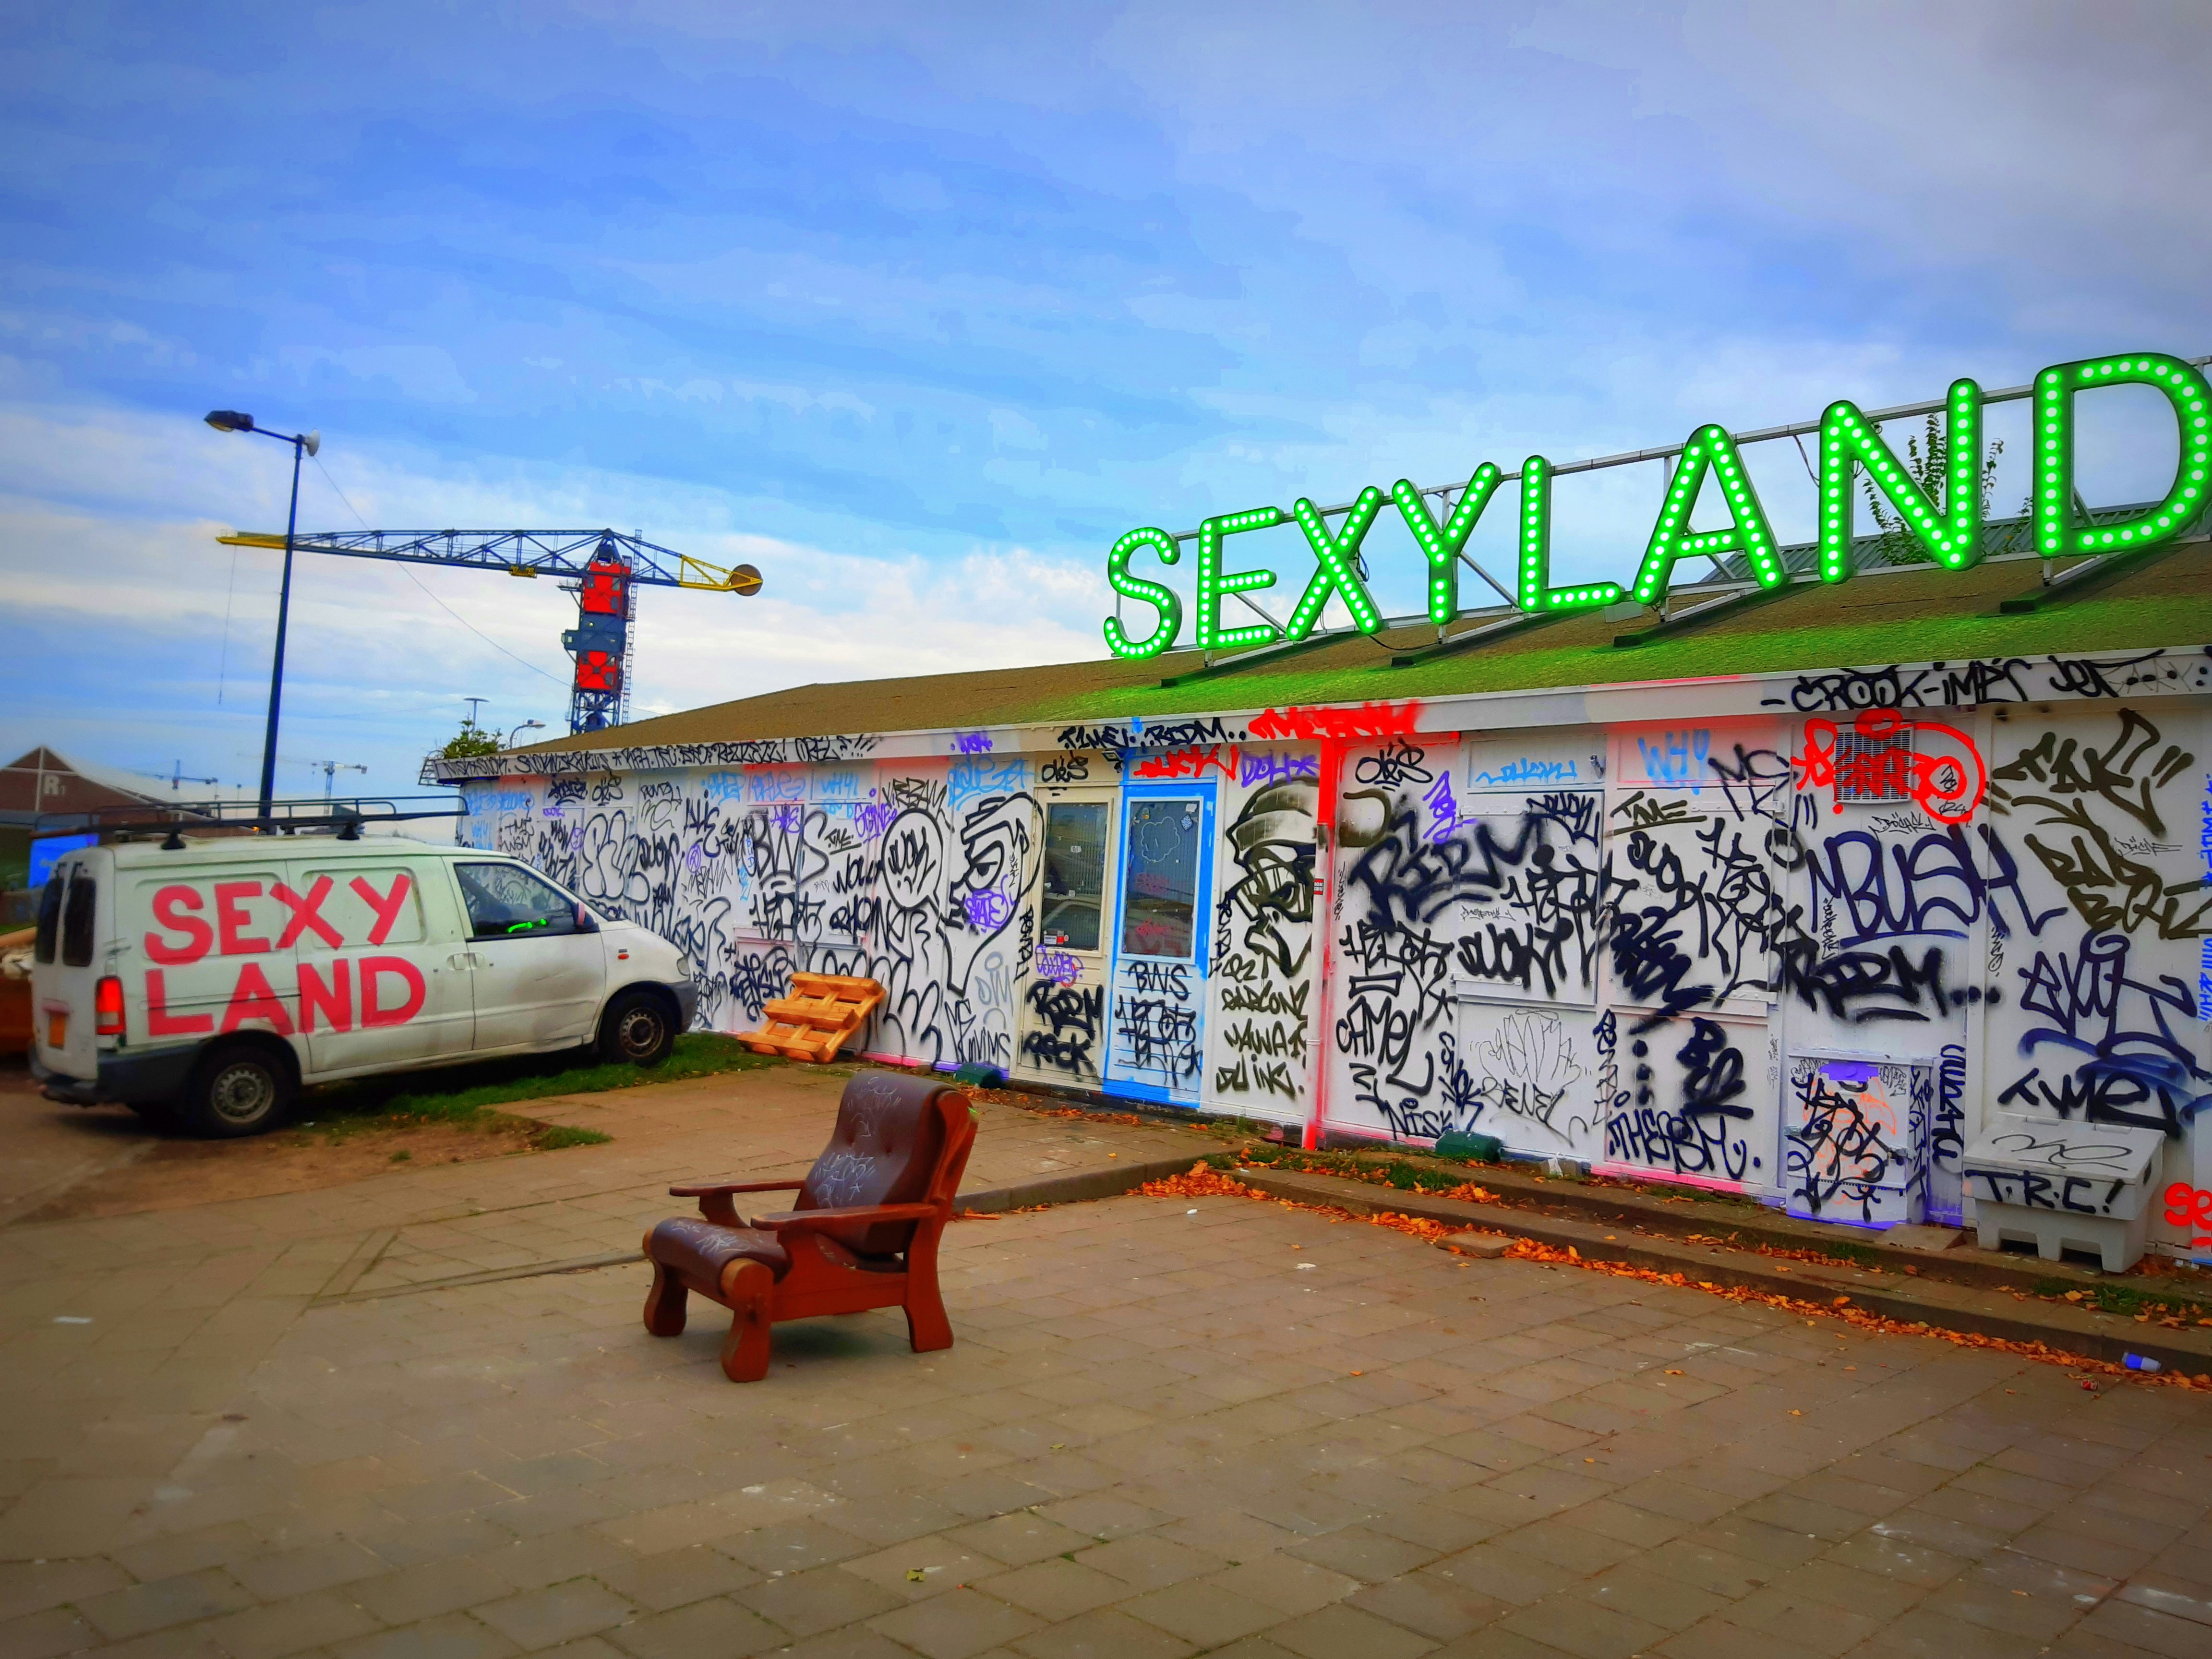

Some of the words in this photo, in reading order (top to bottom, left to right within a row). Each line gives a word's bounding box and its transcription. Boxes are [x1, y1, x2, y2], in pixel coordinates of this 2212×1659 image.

[1103, 352, 2212, 660] SEXYLAND
[144, 874, 411, 965] SEXY
[145, 956, 426, 1037] LAND
